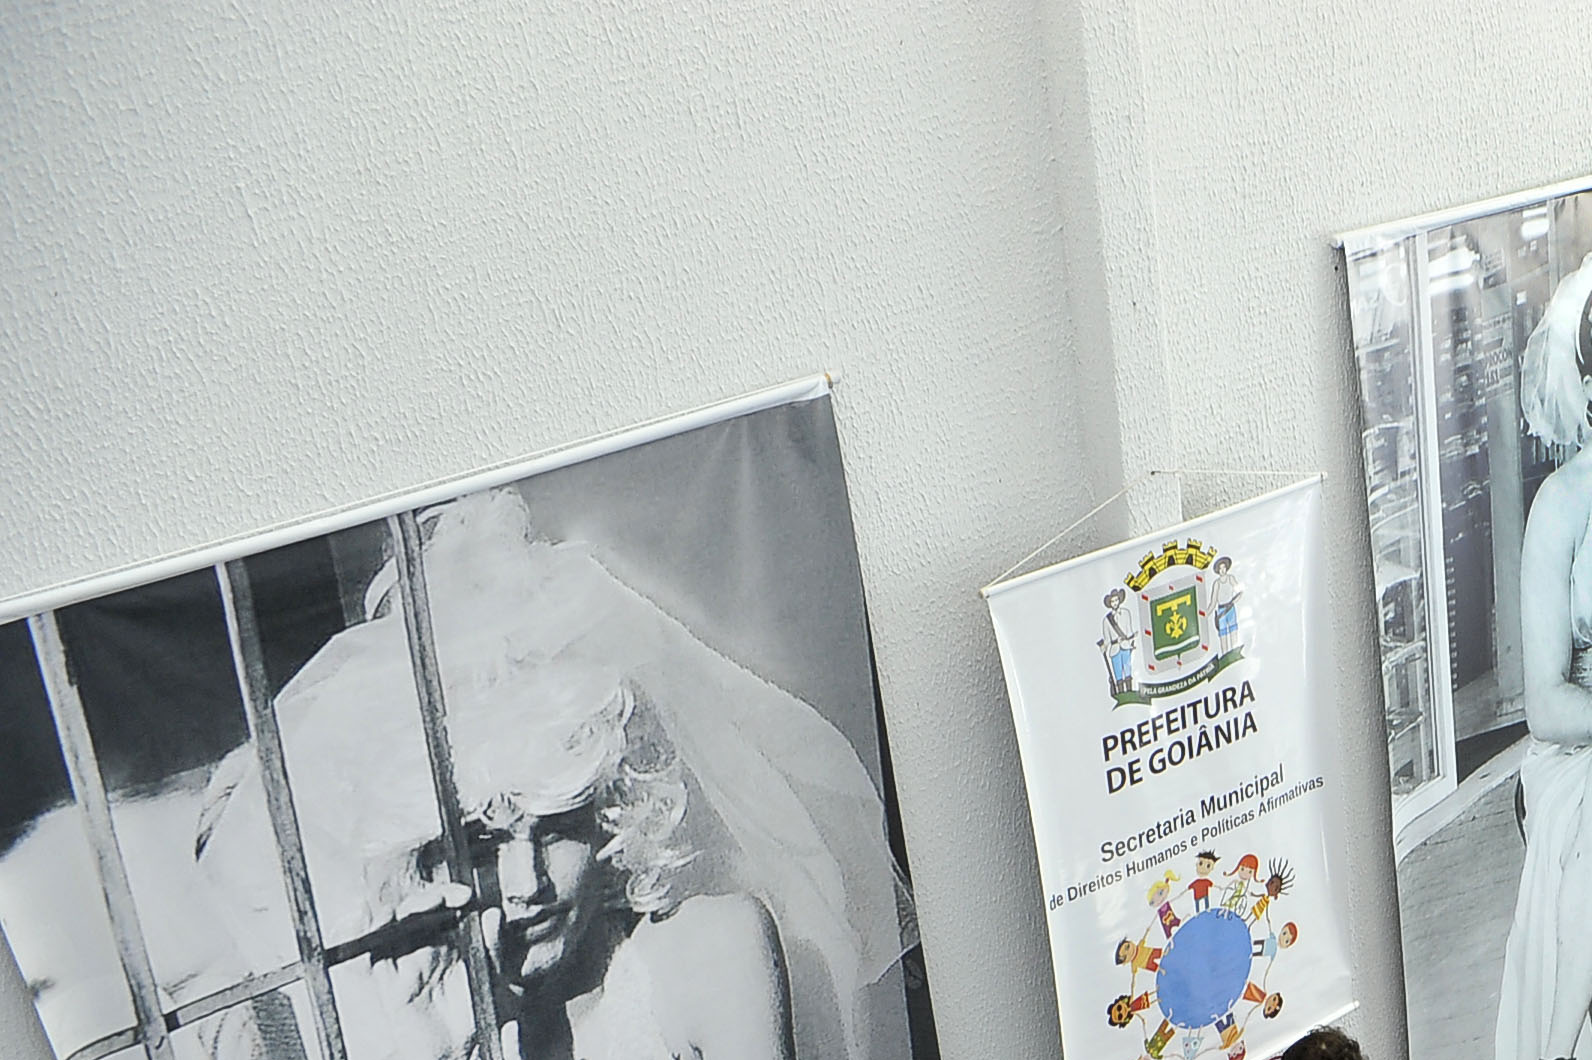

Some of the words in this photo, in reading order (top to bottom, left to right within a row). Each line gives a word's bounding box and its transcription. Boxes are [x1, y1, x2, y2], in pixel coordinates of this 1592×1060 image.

[1102, 680, 1255, 762] PREFEITURA
[1157, 680, 1187, 694] GRANDEZA
[1106, 758, 1143, 794] DE
[1149, 711, 1257, 774] GOIÂNIA
[1049, 894, 1064, 911] de
[1067, 870, 1122, 902] Direitos
[1126, 841, 1188, 878] Humanos
[1190, 834, 1198, 847] e
[1201, 808, 1255, 842] Políticas
[1258, 775, 1324, 816] Afirmativas
[1100, 807, 1196, 863] Secretaria
[1200, 763, 1284, 819] Municipal
